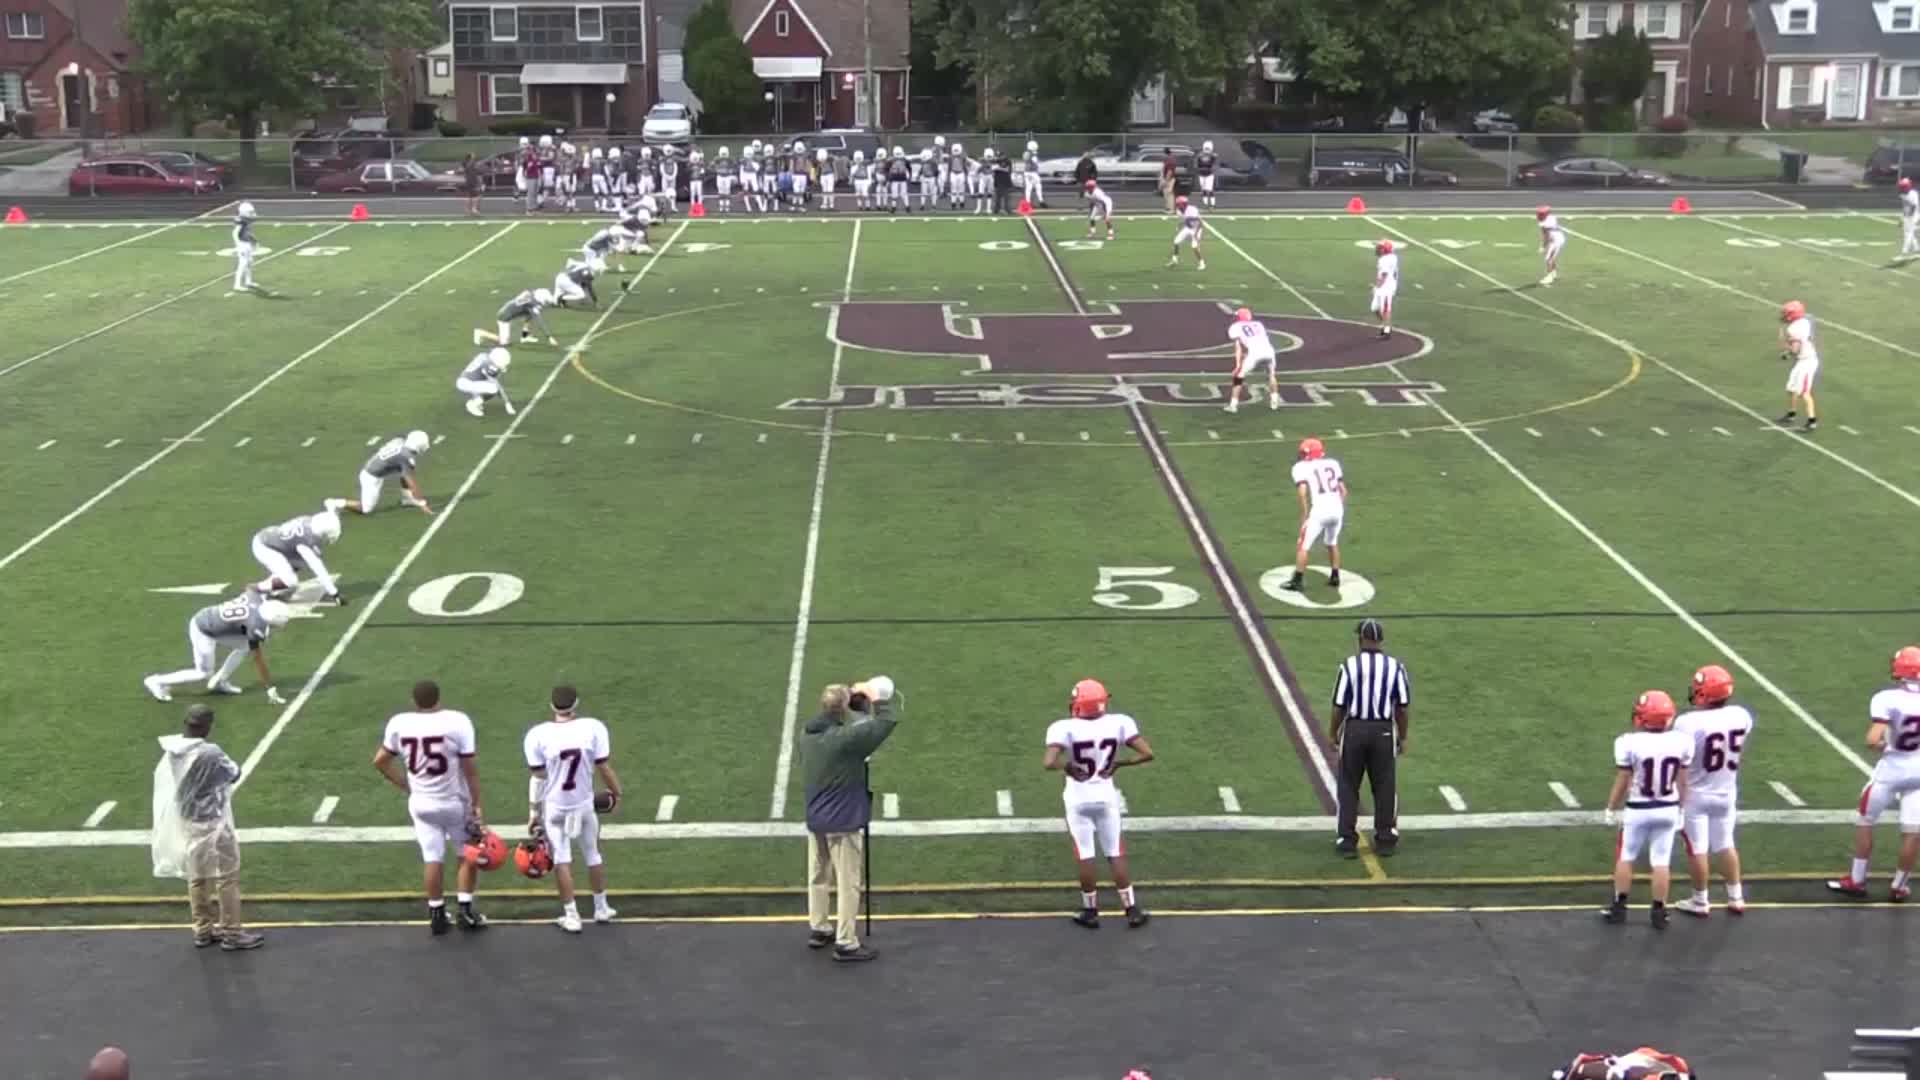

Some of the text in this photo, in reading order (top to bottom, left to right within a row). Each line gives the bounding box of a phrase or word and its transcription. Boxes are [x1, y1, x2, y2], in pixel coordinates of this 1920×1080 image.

[777, 381, 1448, 411] JESUIT
[1313, 466, 1337, 494] 12
[401, 736, 449, 776] 75
[559, 748, 582, 791] 7
[1703, 728, 1746, 772] 65
[1640, 756, 1681, 798] 10
